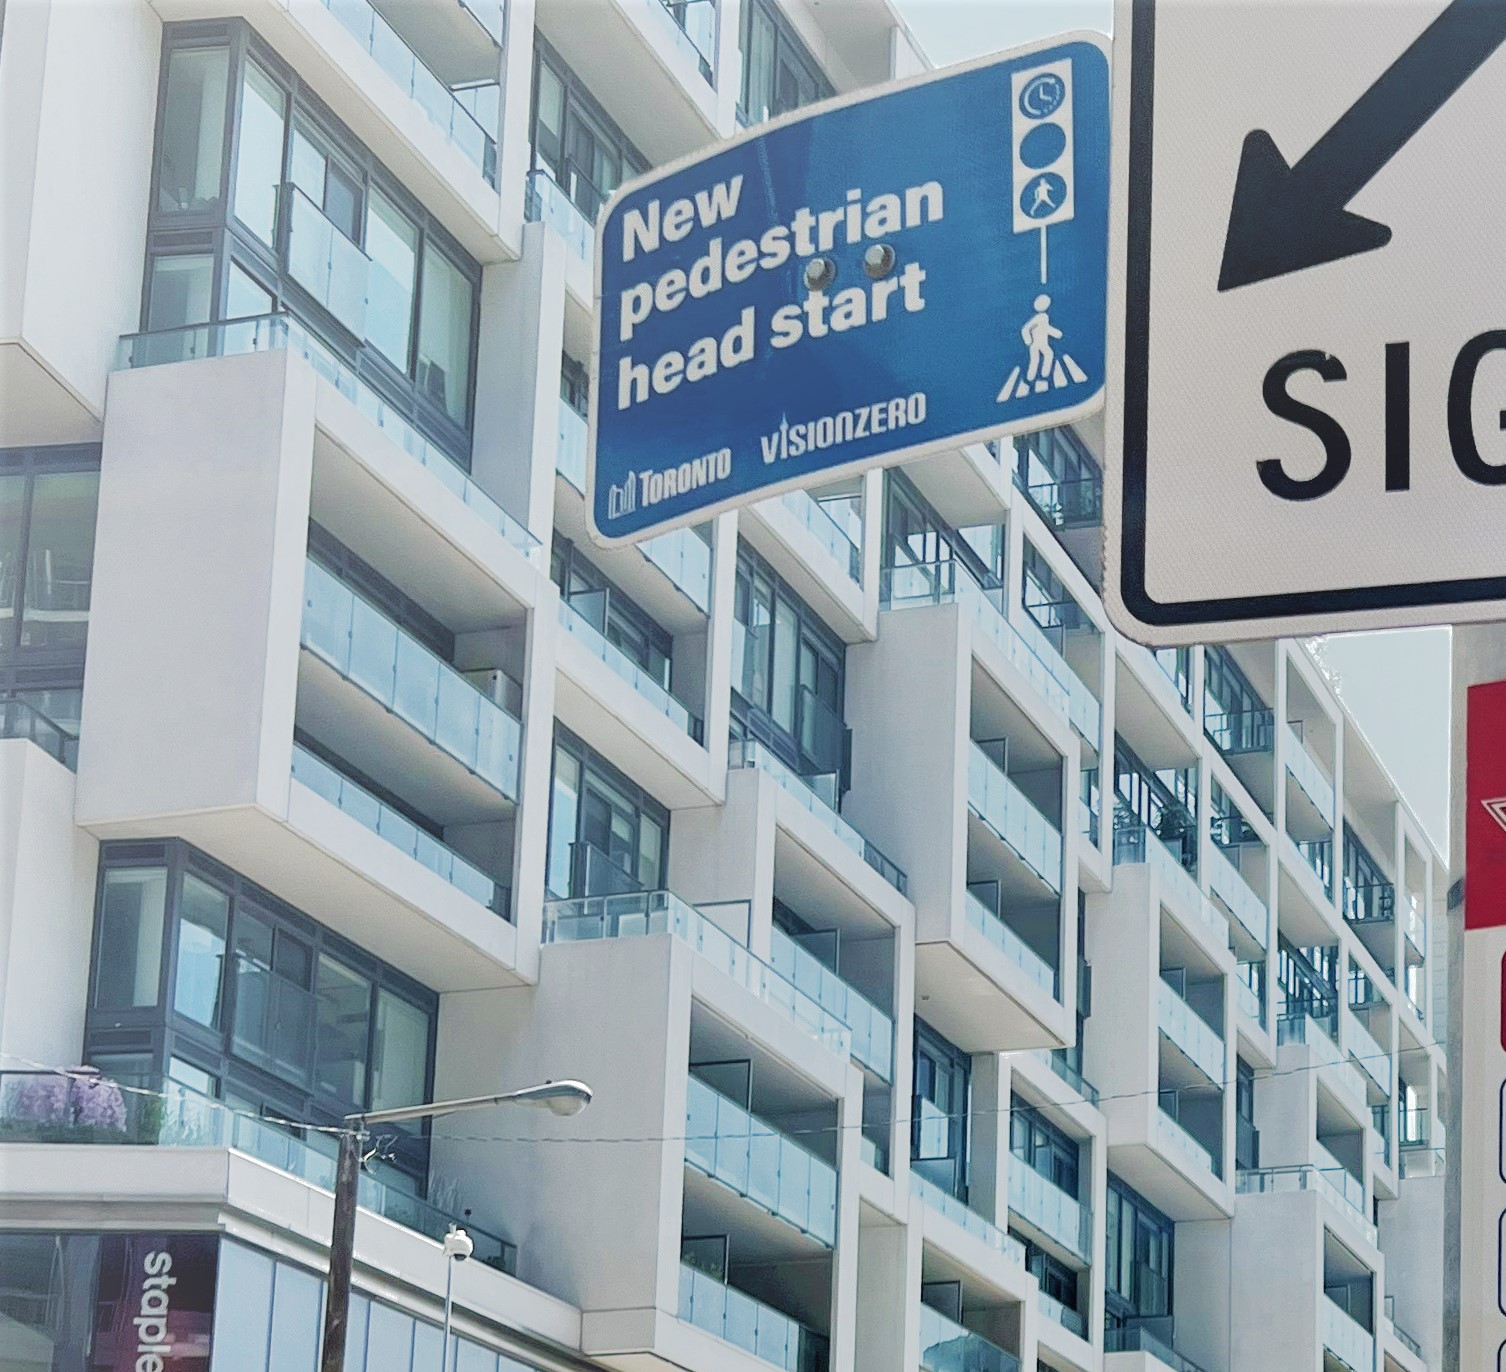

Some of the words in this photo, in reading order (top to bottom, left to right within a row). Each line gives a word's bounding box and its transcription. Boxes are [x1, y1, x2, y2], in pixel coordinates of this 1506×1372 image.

[619, 180, 944, 341] pedestrian
[622, 175, 743, 262] New
[617, 307, 755, 410] head
[769, 261, 927, 349] start
[639, 447, 732, 507] TORONTO
